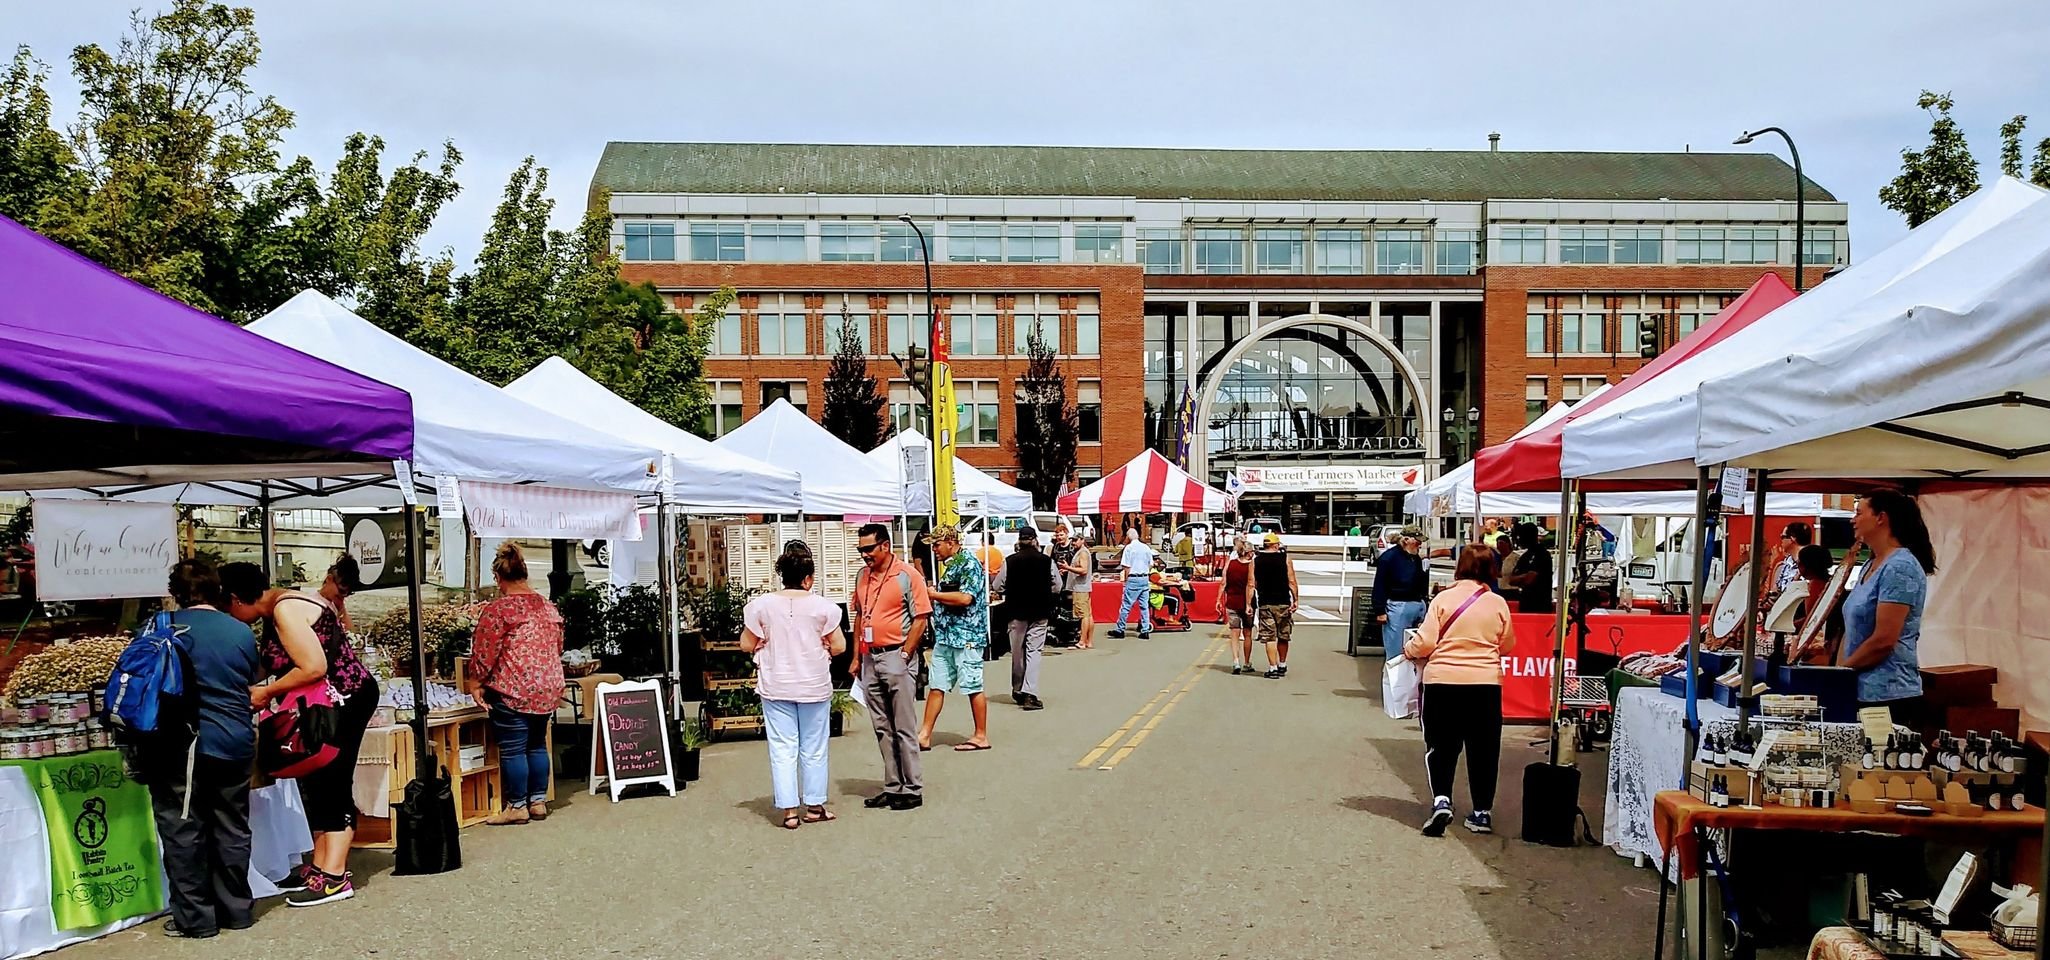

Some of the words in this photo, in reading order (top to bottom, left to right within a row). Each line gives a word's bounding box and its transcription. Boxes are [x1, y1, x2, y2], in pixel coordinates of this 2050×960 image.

[1235, 437, 1319, 450] EVERETT
[1337, 436, 1425, 450] STATION
[1264, 469, 1303, 480] Everett
[1307, 469, 1354, 480] Farmers
[1357, 468, 1396, 480] Market
[472, 506, 496, 529] Old
[501, 508, 553, 529] Fashioned
[608, 697, 619, 706] Old
[613, 741, 639, 752] CANDY
[124, 862, 135, 871] Tea
